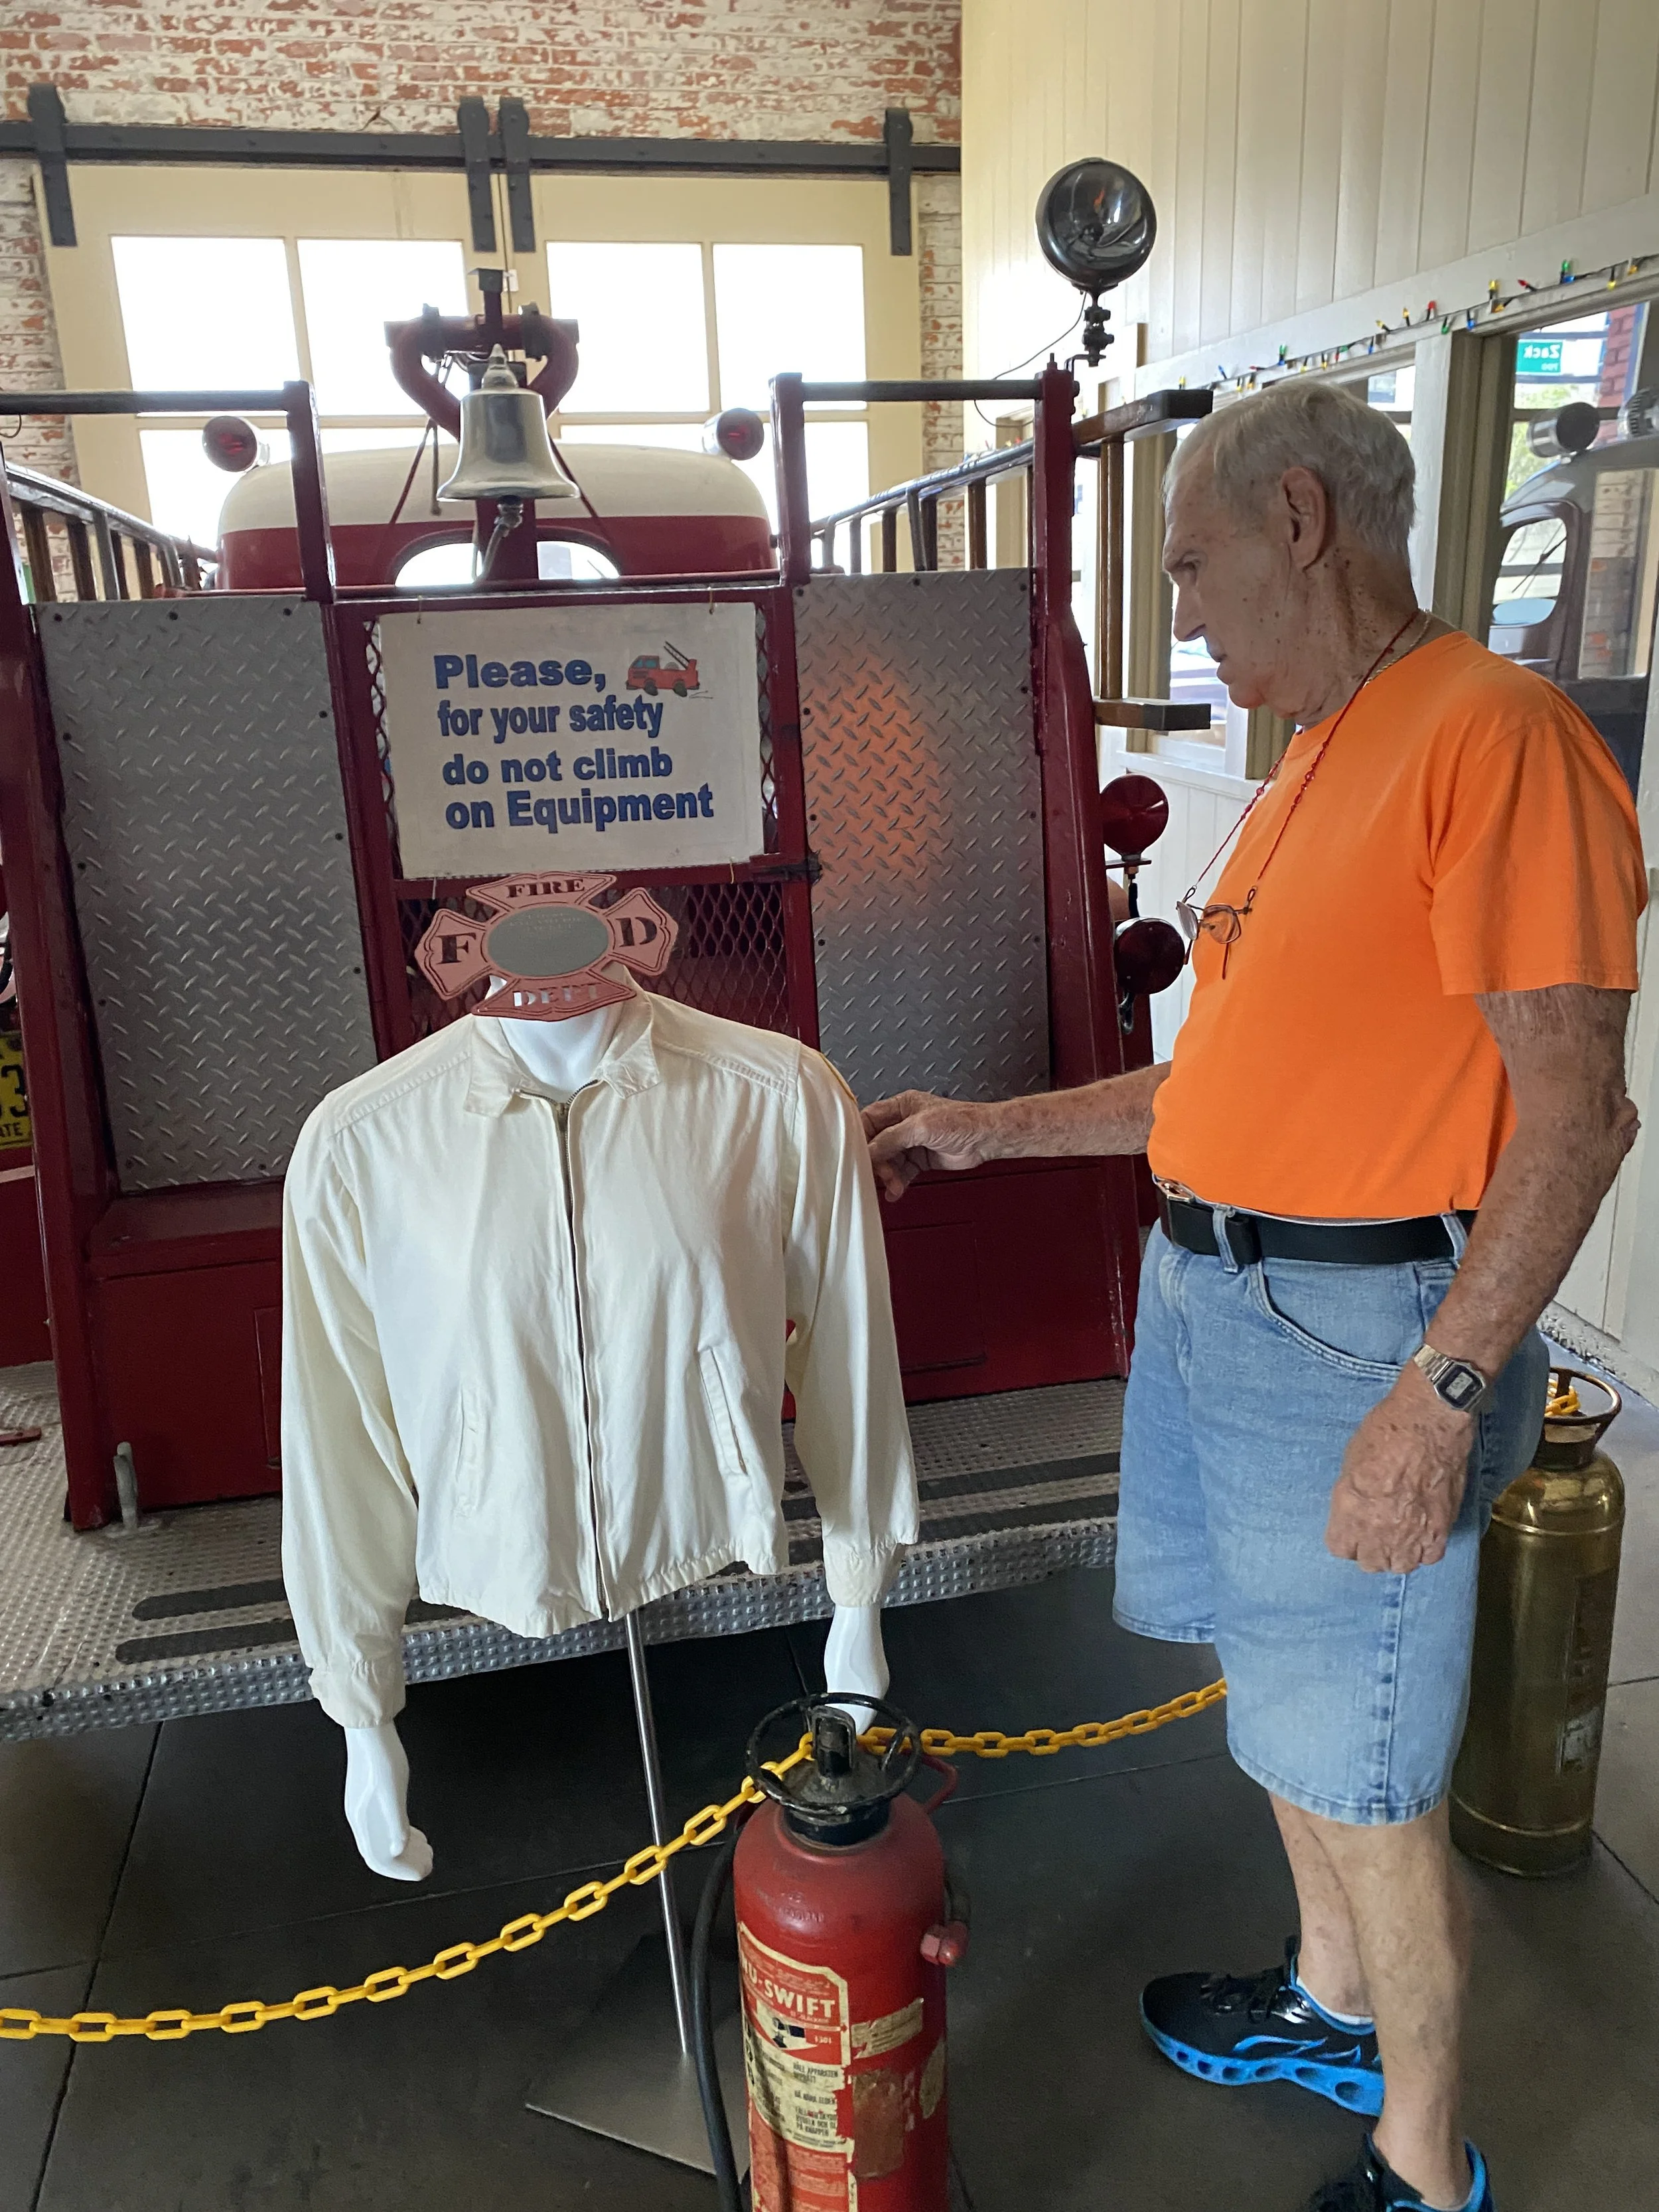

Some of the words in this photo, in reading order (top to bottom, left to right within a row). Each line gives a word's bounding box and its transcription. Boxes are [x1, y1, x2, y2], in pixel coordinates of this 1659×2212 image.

[434, 654, 605, 692] Please,
[438, 700, 482, 736] for
[493, 705, 560, 743] your
[570, 695, 663, 737] safety
[443, 754, 488, 784] do
[501, 750, 562, 783] not
[573, 747, 673, 778] climb
[445, 799, 494, 829] on
[507, 782, 714, 834] Equipment
[506, 879, 585, 898] FIRE
[436, 932, 476, 964] F
[616, 917, 658, 947] D
[513, 982, 601, 1007] DEPT
[0, 1064, 28, 1118] 3
